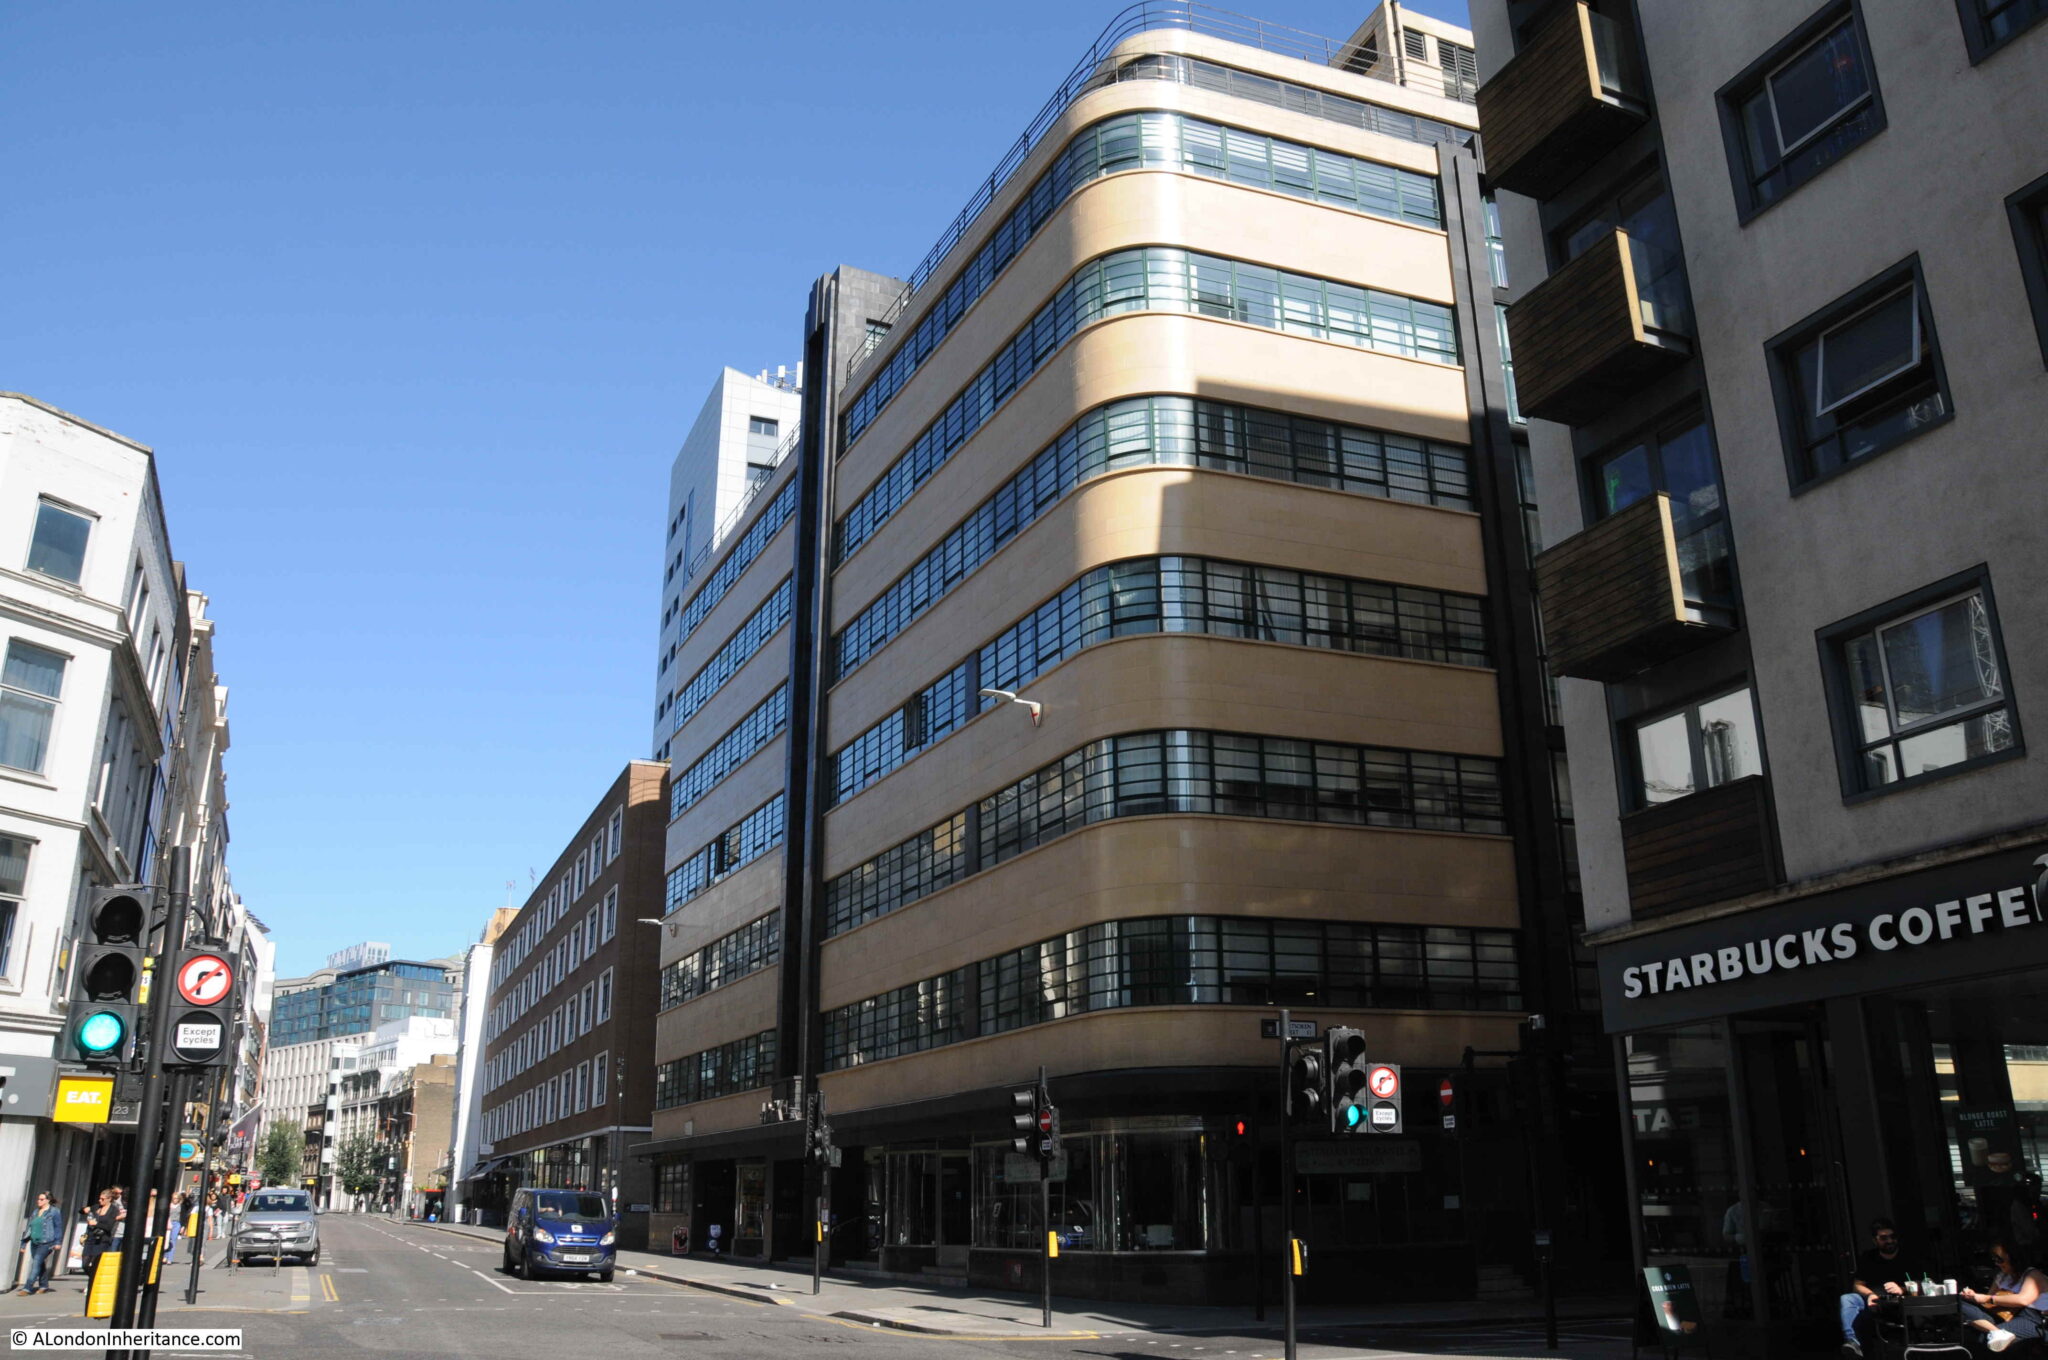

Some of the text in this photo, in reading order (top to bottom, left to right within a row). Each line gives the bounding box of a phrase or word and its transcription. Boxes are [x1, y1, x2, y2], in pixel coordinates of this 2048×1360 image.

[1622, 883, 2044, 999] STARBUCKS COFFE
[183, 1027, 216, 1037] Except
[183, 1036, 214, 1045] cycles
[66, 1090, 102, 1105] EAT.
[1974, 1119, 1995, 1128] LATTE
